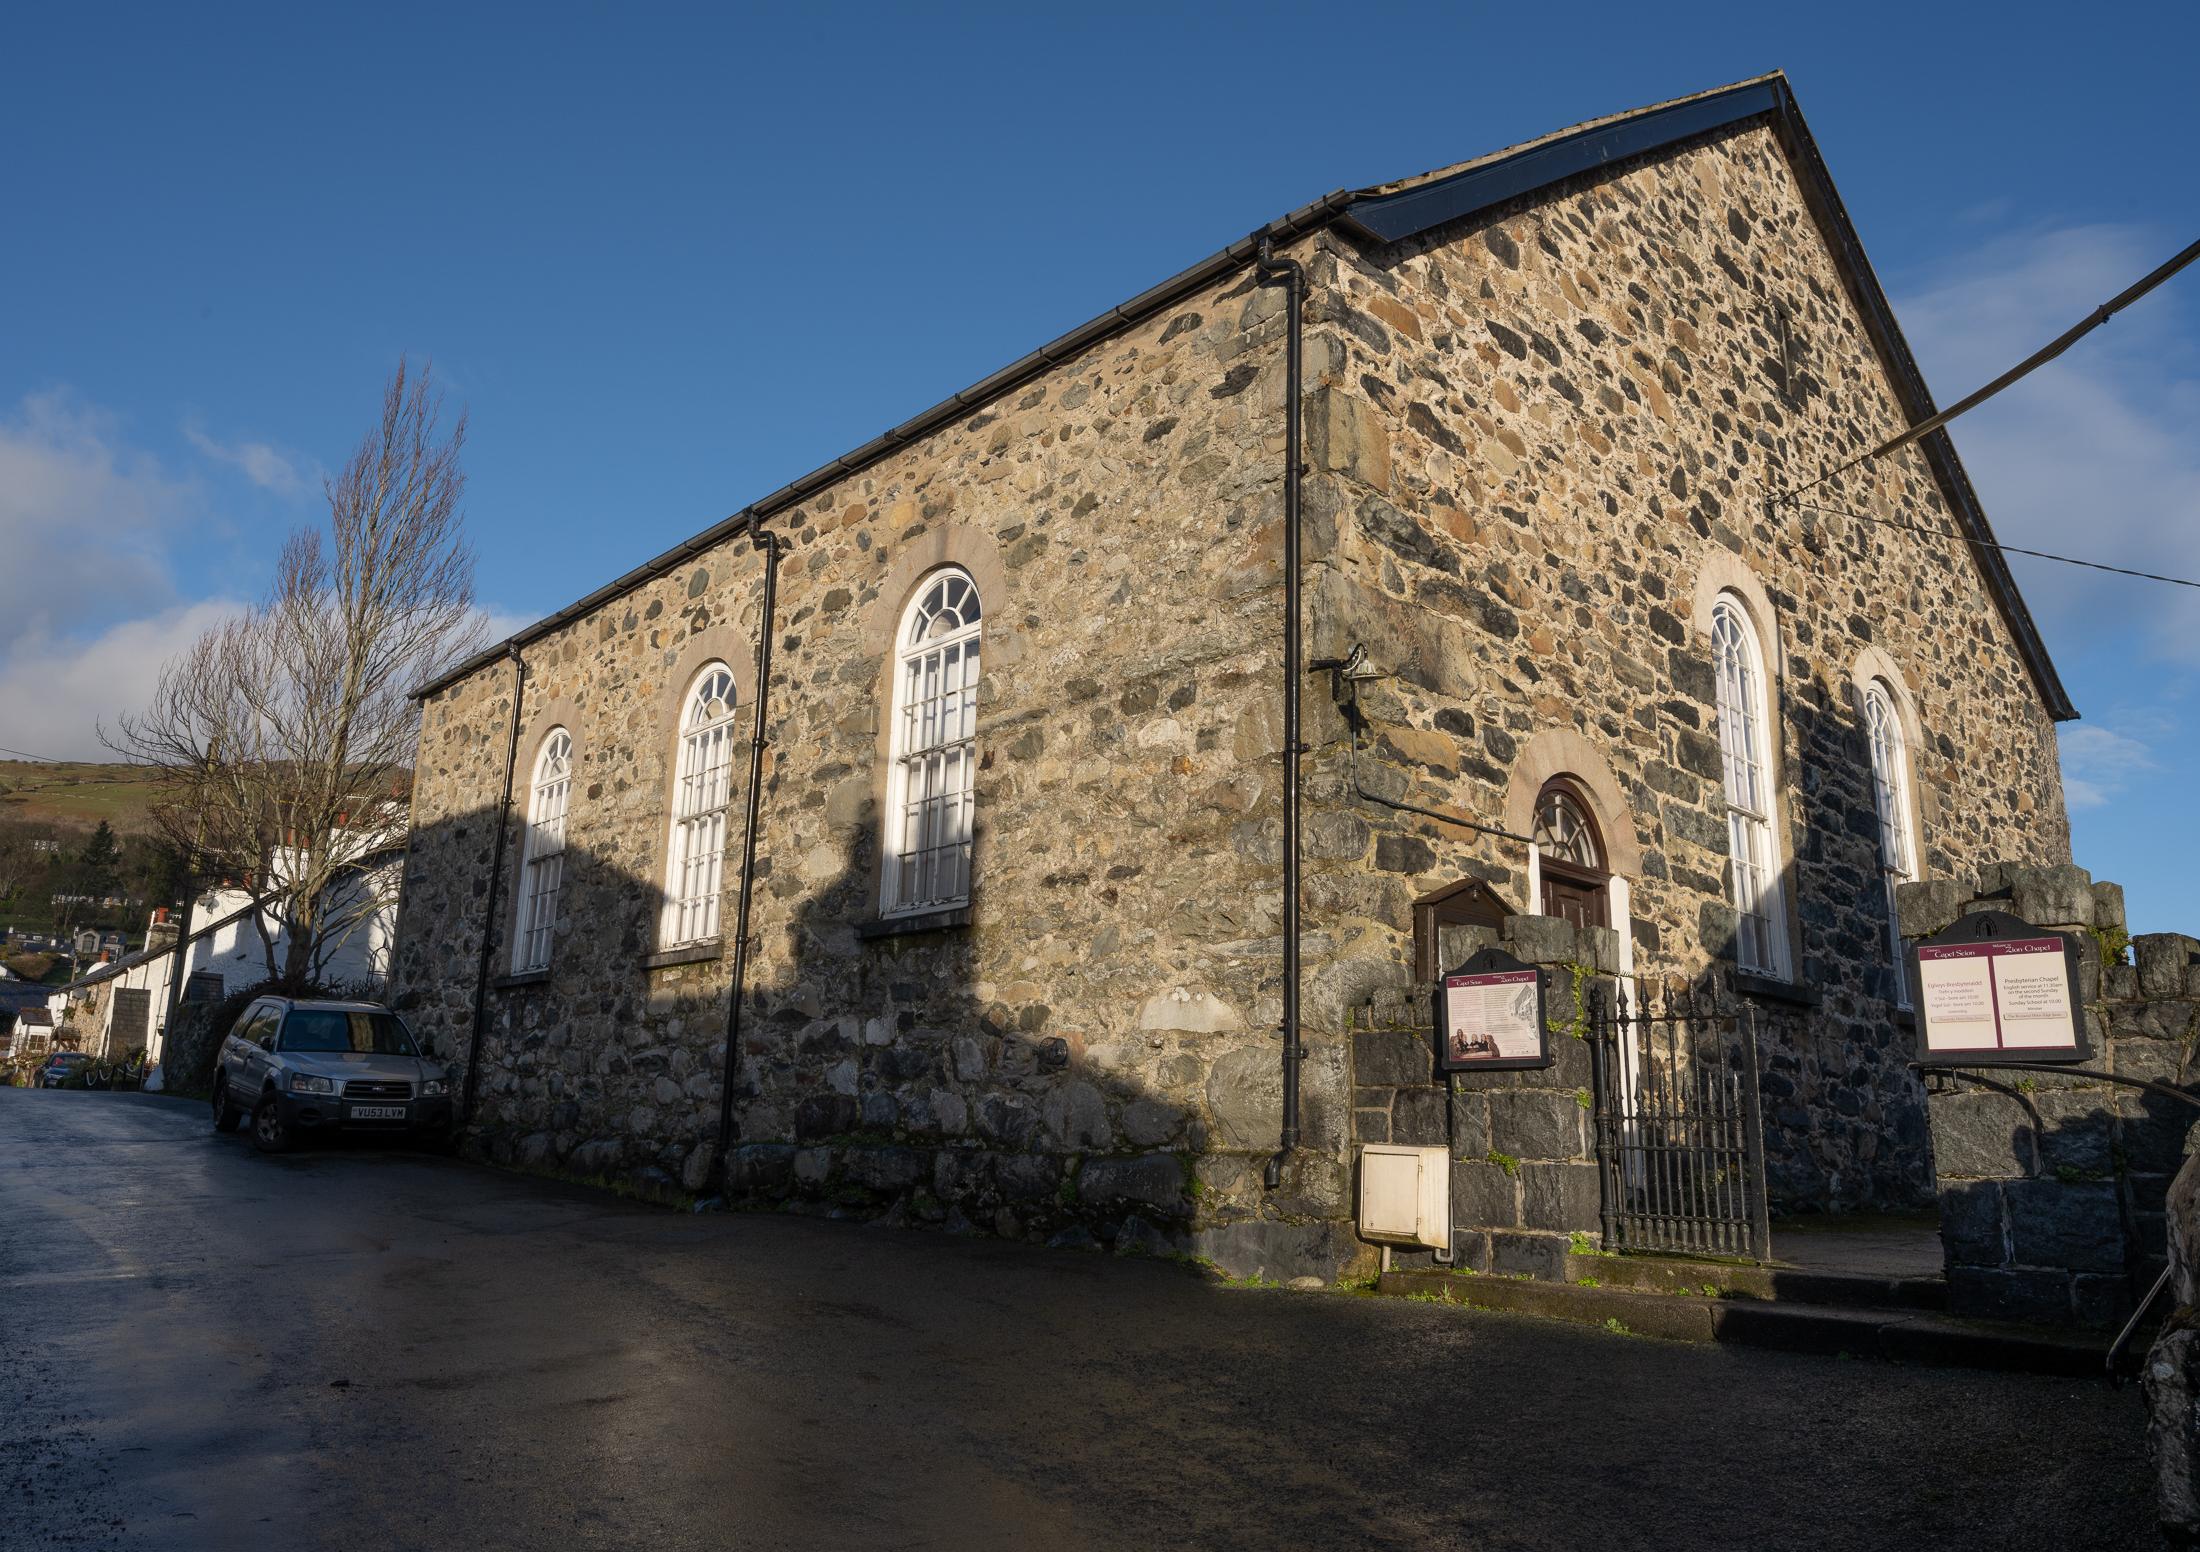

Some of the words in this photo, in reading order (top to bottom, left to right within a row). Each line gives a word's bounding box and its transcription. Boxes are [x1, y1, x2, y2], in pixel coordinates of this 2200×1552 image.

[2005, 945, 2023, 953] Zion
[2024, 944, 2050, 953] Chapel
[1934, 951, 1955, 959] Capel
[358, 1107, 383, 1118] VU53
